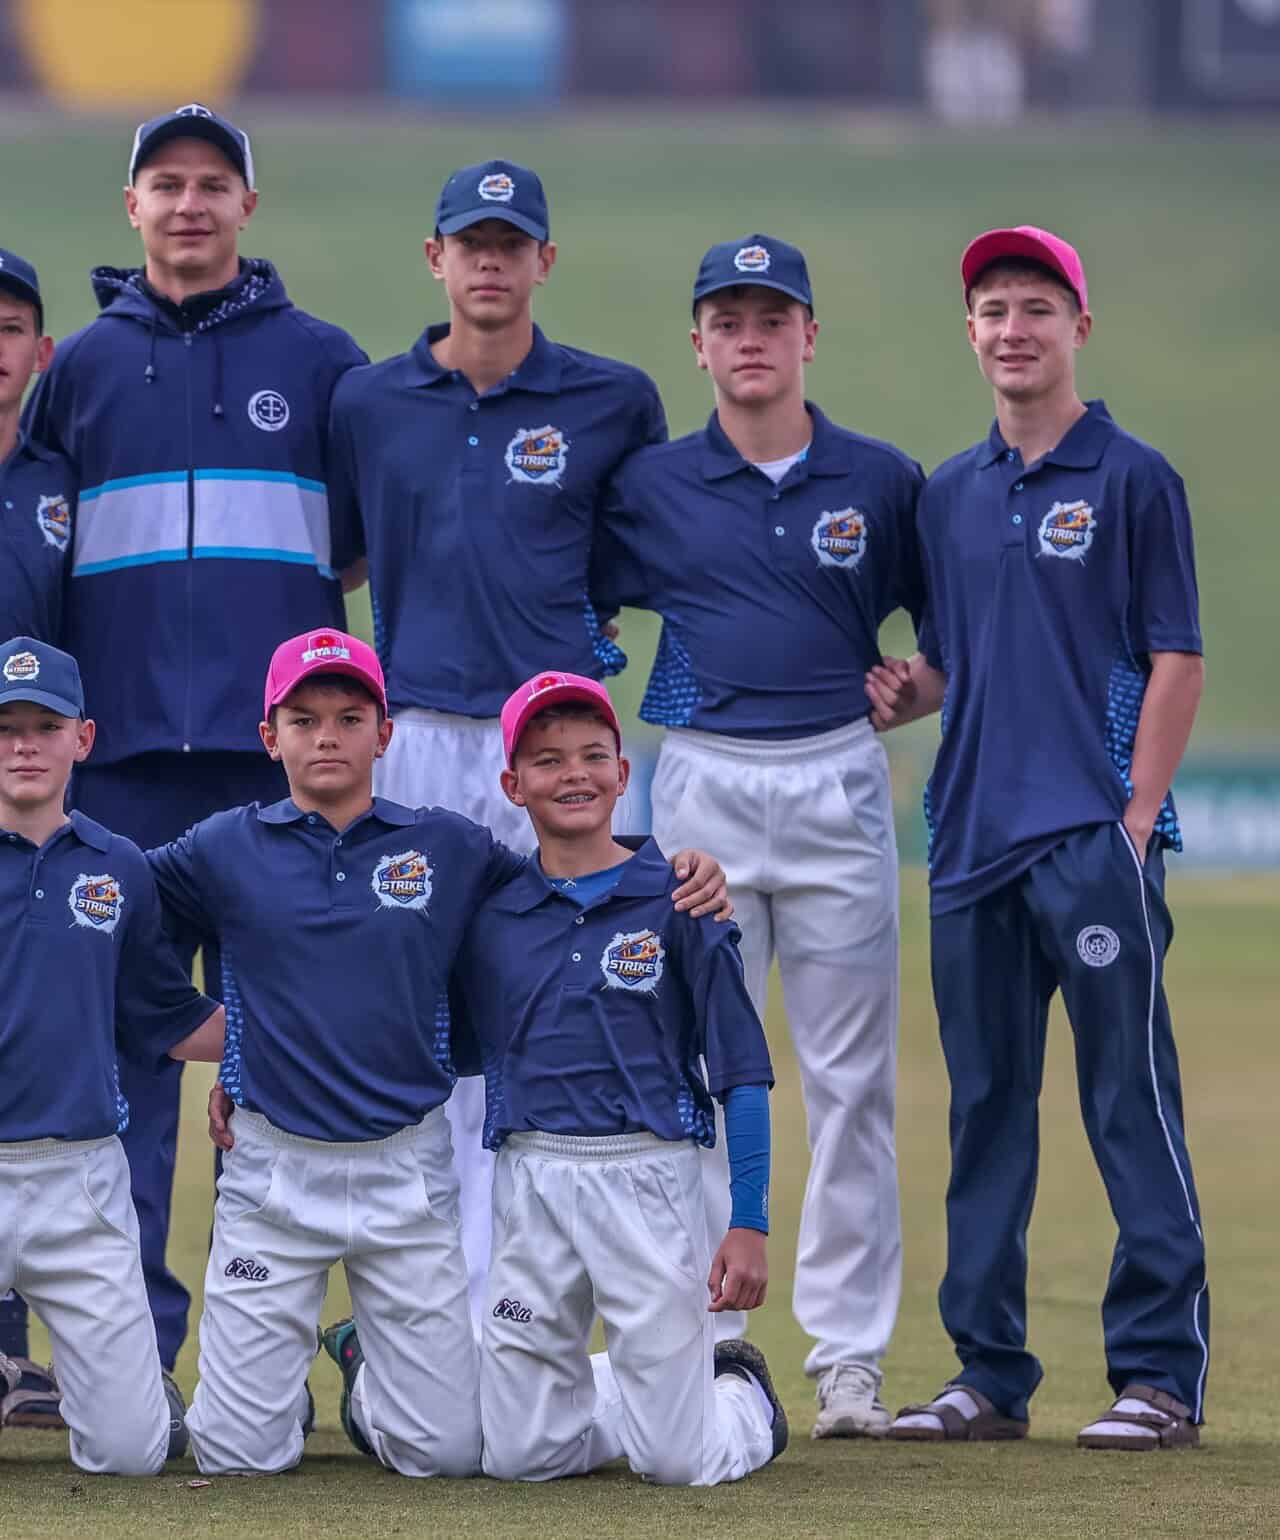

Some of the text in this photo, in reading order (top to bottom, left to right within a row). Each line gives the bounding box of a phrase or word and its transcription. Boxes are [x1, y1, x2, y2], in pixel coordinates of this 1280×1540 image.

[381, 881, 424, 891] STRIKE
[77, 898, 116, 916] STRIKE
[609, 959, 655, 973] STRIKE
